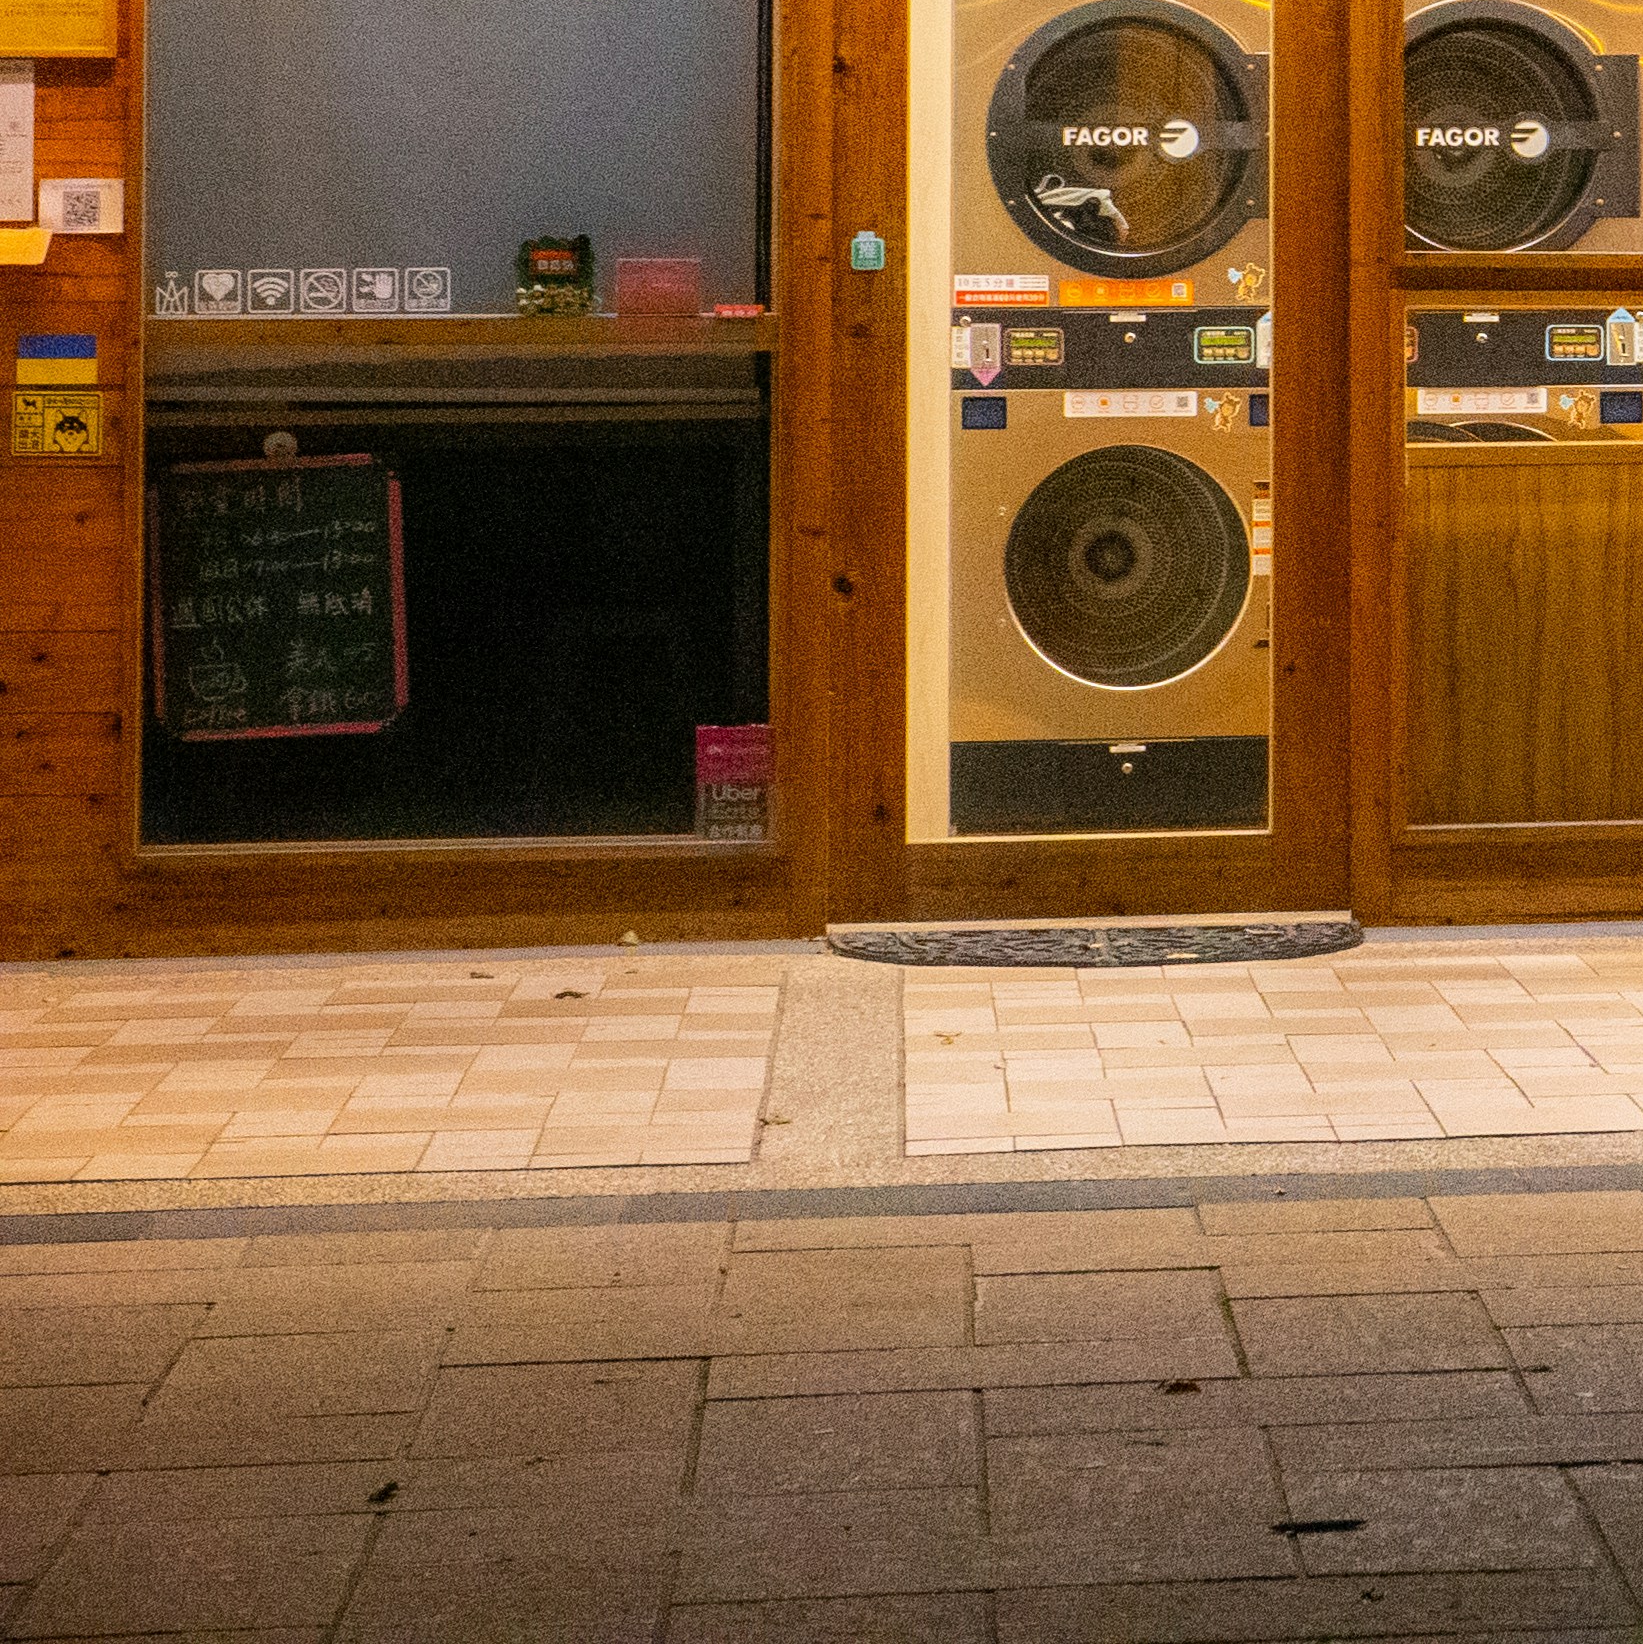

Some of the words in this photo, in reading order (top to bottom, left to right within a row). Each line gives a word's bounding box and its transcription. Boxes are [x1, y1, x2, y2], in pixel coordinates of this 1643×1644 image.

[1063, 126, 1148, 147] FAGOR
[1416, 127, 1500, 147] FAGOR
[711, 783, 761, 801] Uber
